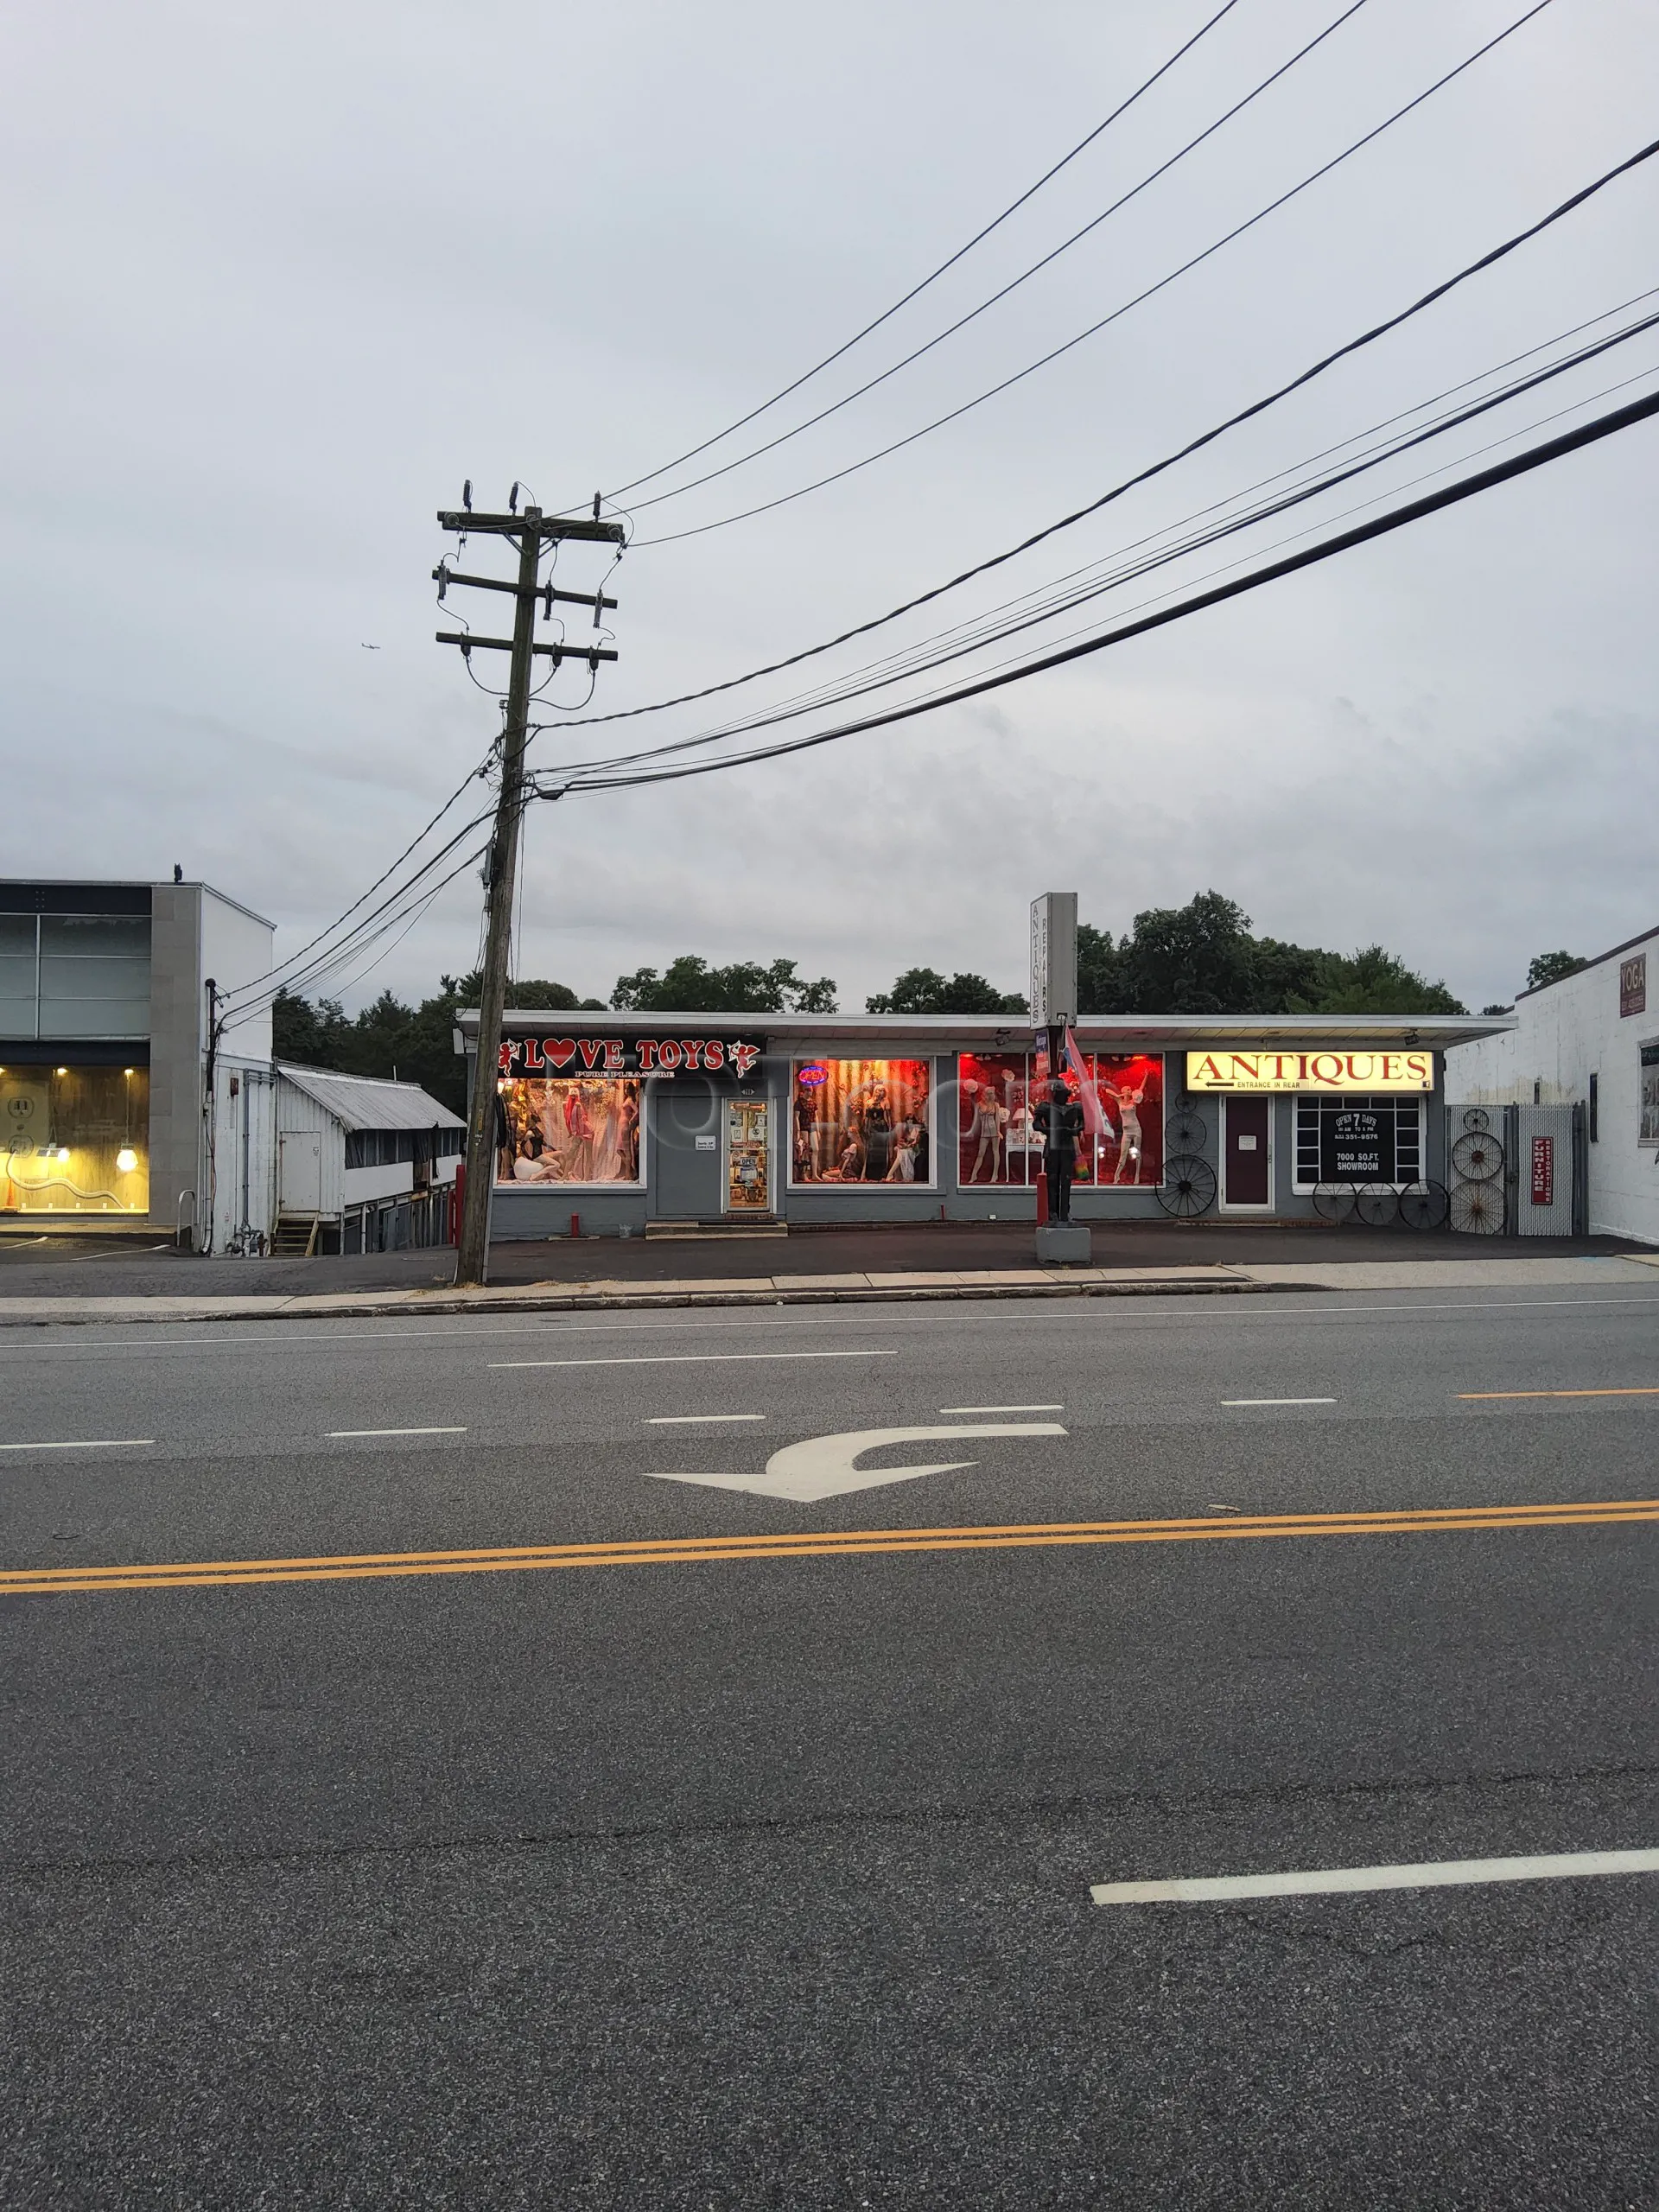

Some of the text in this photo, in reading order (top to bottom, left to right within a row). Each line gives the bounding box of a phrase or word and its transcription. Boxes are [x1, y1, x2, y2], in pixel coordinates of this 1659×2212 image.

[1621, 960, 1644, 993] YOGA
[636, 1039, 724, 1070] TOYS
[798, 1071, 827, 1081] OPEN
[1192, 1054, 1427, 1085] ANTIQUES
[1335, 1113, 1377, 1127] OPEN 7 DAYS
[1336, 1153, 1355, 1161] 7000
[1337, 1161, 1379, 1171] SHOWROOM
[1534, 1140, 1545, 1192] FURNITURE
